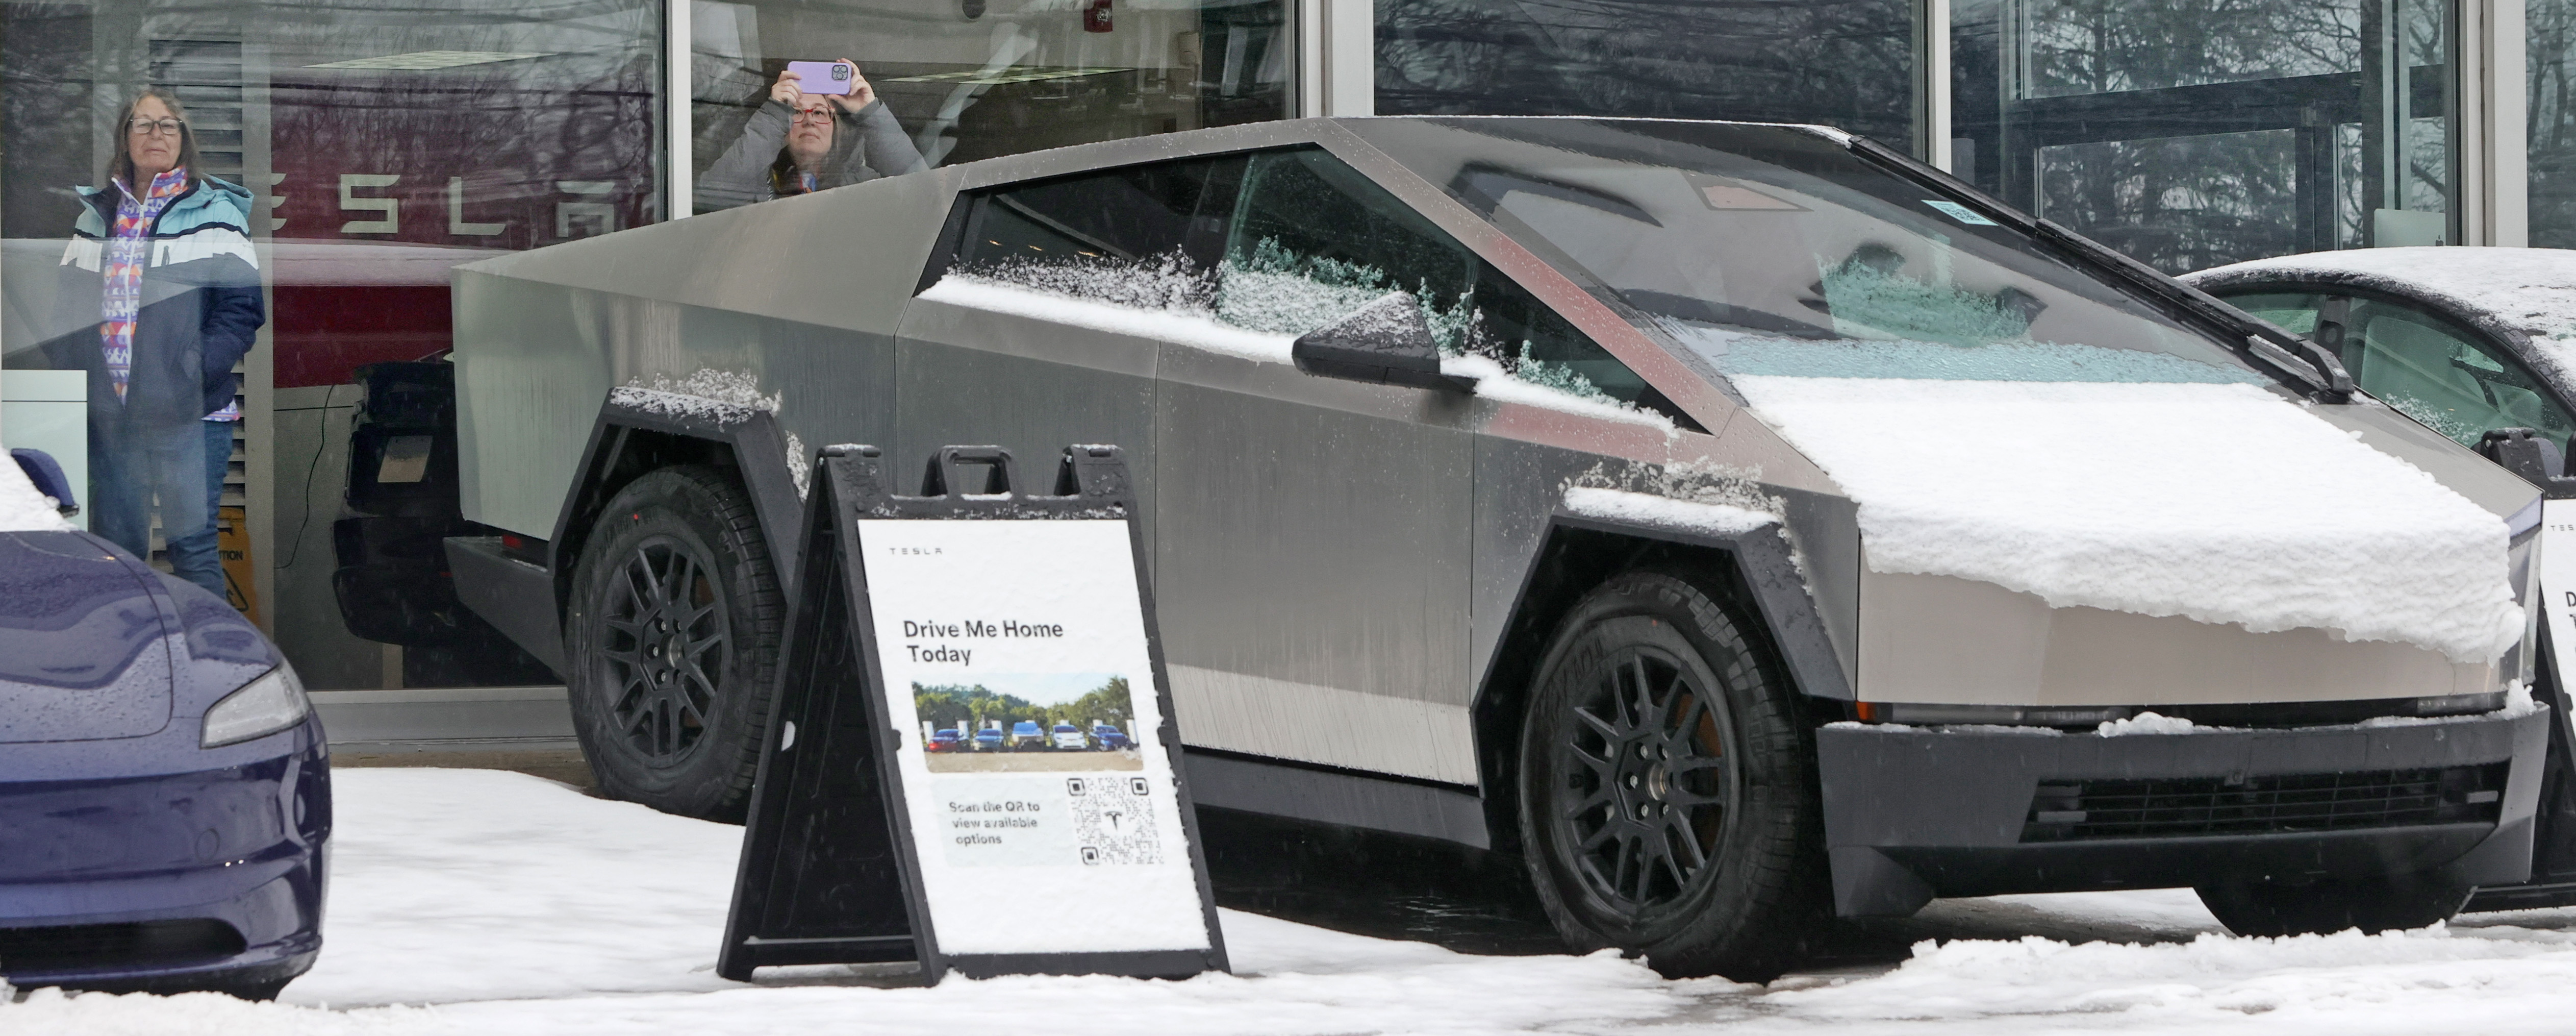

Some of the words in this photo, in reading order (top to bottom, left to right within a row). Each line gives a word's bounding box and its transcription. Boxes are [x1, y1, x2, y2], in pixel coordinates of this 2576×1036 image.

[272, 173, 615, 238] SLA
[219, 550, 243, 560] TION
[889, 547, 942, 555] TESLA
[903, 620, 960, 638] Drive
[965, 620, 997, 638] Me
[1002, 620, 1064, 638] Home
[906, 644, 972, 666] Today
[949, 801, 980, 812] Scan
[982, 801, 1003, 812] the
[1005, 801, 1025, 812] QR
[1027, 802, 1041, 812] to
[952, 818, 980, 828] view
[984, 817, 1038, 828] available
[955, 833, 1002, 847] options
